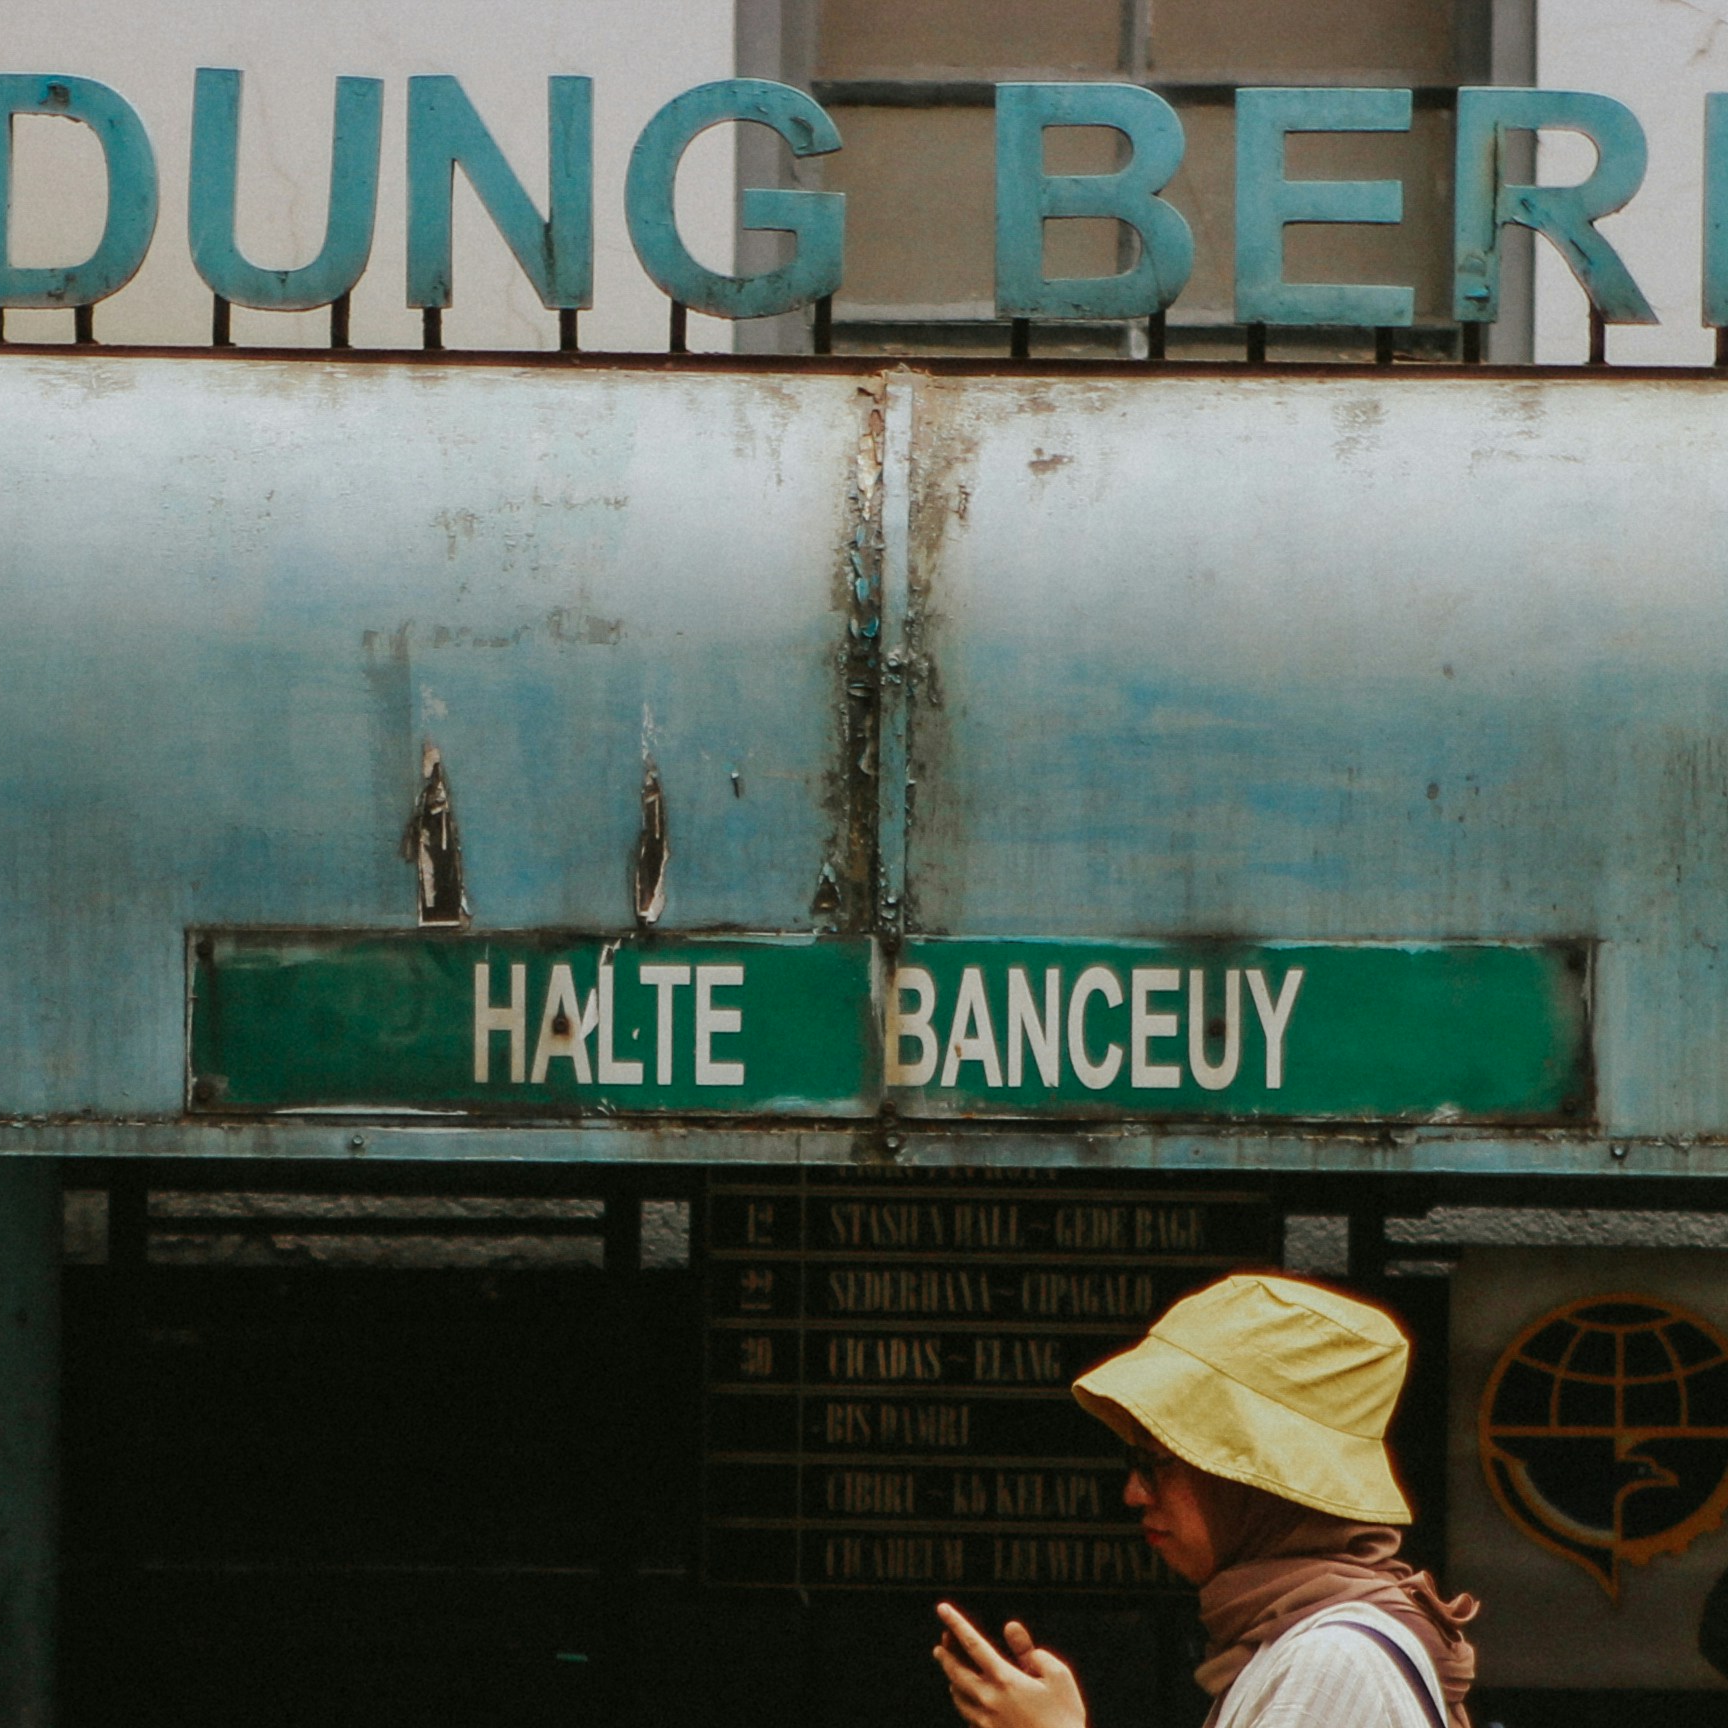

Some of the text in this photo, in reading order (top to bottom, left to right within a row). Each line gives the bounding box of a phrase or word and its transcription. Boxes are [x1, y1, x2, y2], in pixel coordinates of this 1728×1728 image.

[472, 963, 1305, 1091] HALTE BANCEUY
[828, 1337, 1062, 1382] CICADAS ELANG
[826, 1402, 872, 1443] BIS
